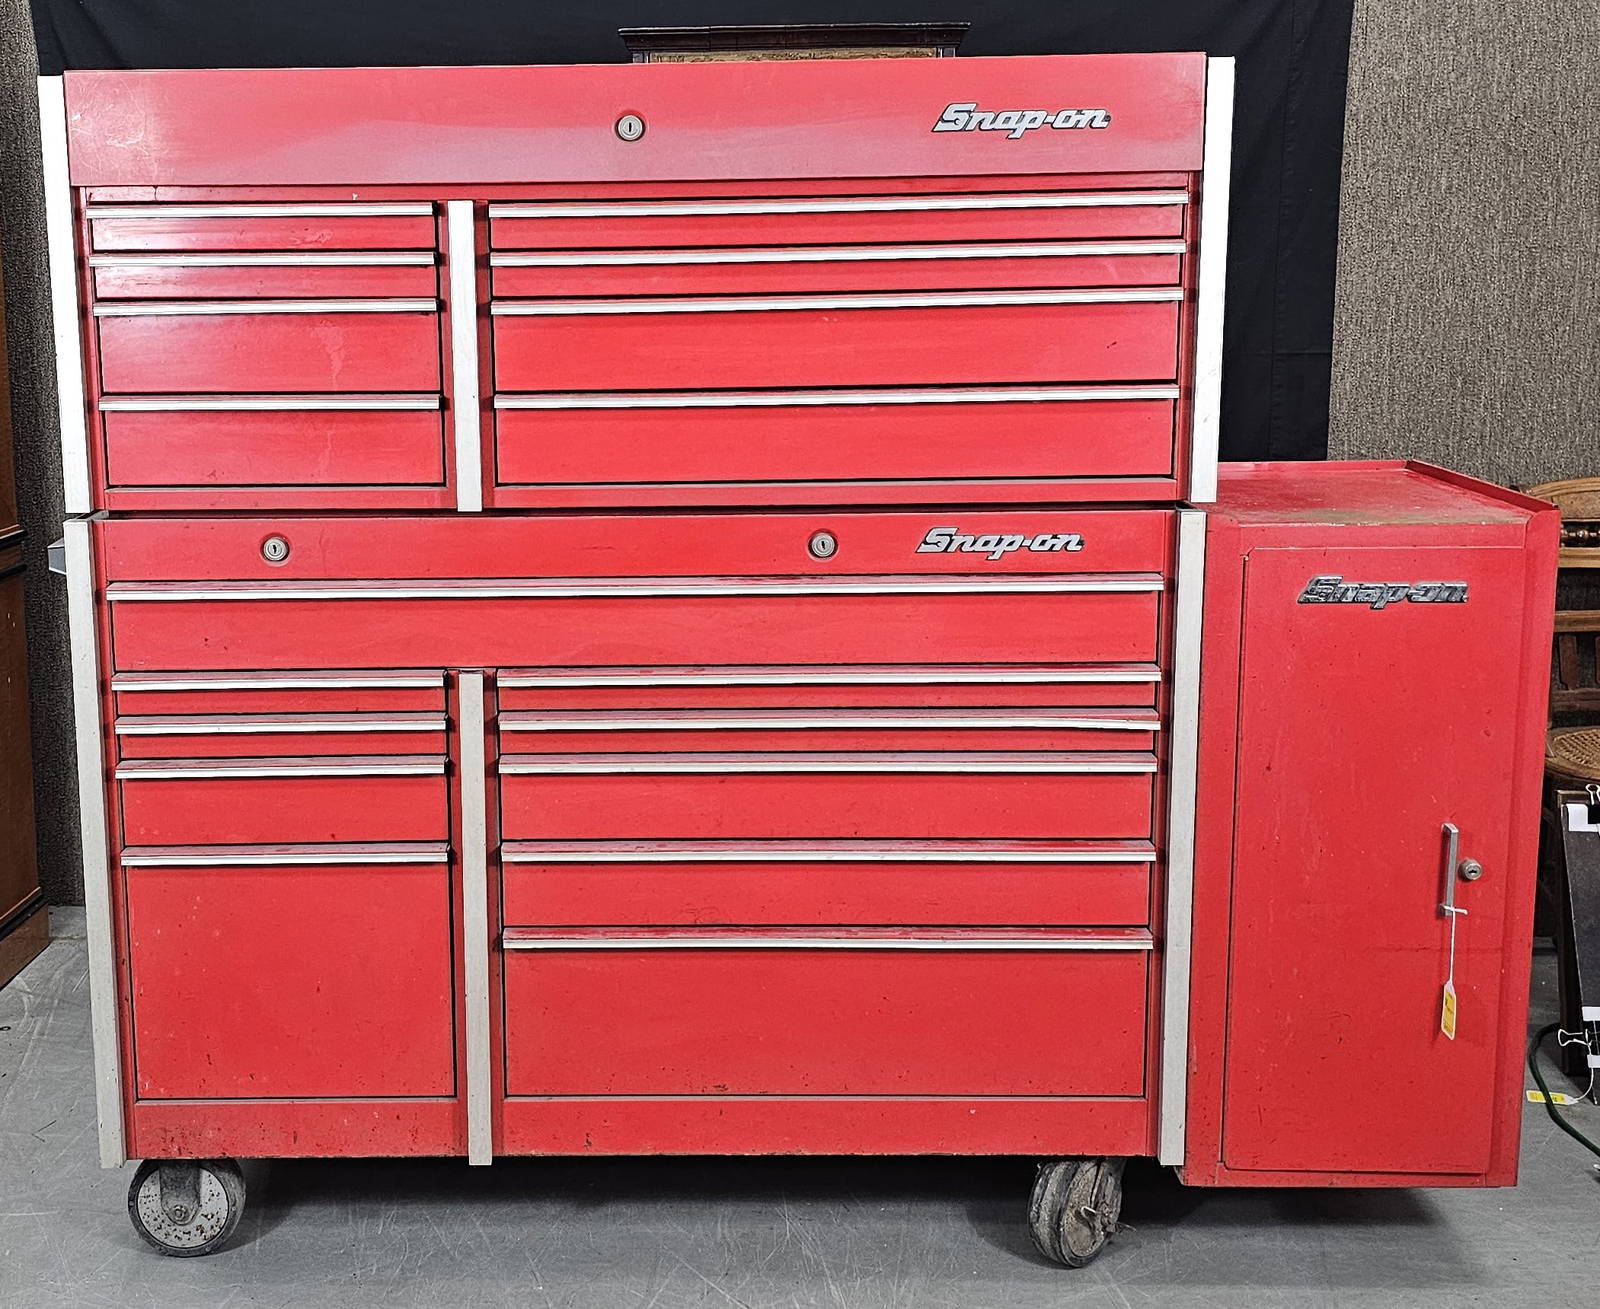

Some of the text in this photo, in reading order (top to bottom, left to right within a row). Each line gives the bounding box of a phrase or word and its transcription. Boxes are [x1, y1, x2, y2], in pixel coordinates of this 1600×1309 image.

[931, 102, 1111, 139] Snap-on
[915, 527, 1085, 560] Snap-on
[1297, 574, 1468, 610] Snap-on
